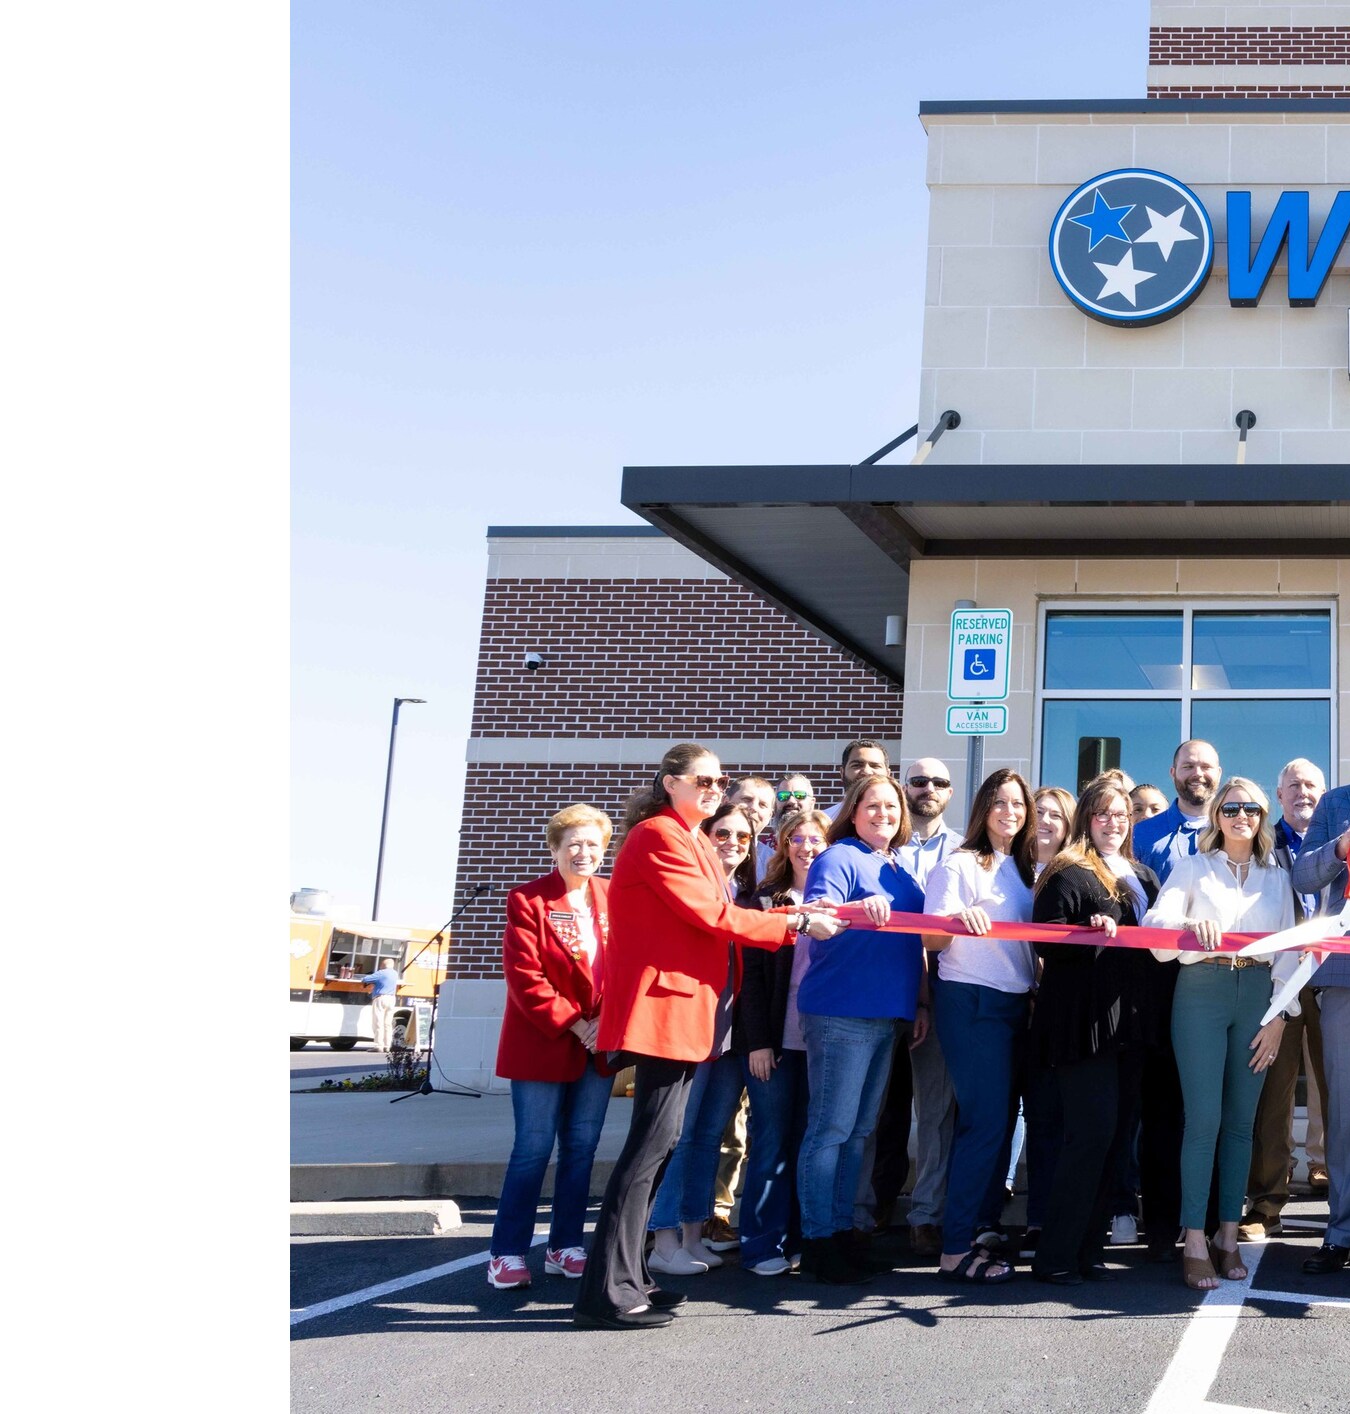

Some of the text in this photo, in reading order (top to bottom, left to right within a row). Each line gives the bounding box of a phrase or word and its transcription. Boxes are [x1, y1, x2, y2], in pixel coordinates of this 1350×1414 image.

[956, 618, 1007, 629] RESERVED
[958, 634, 1003, 645] PARKING
[967, 712, 989, 720] VAN
